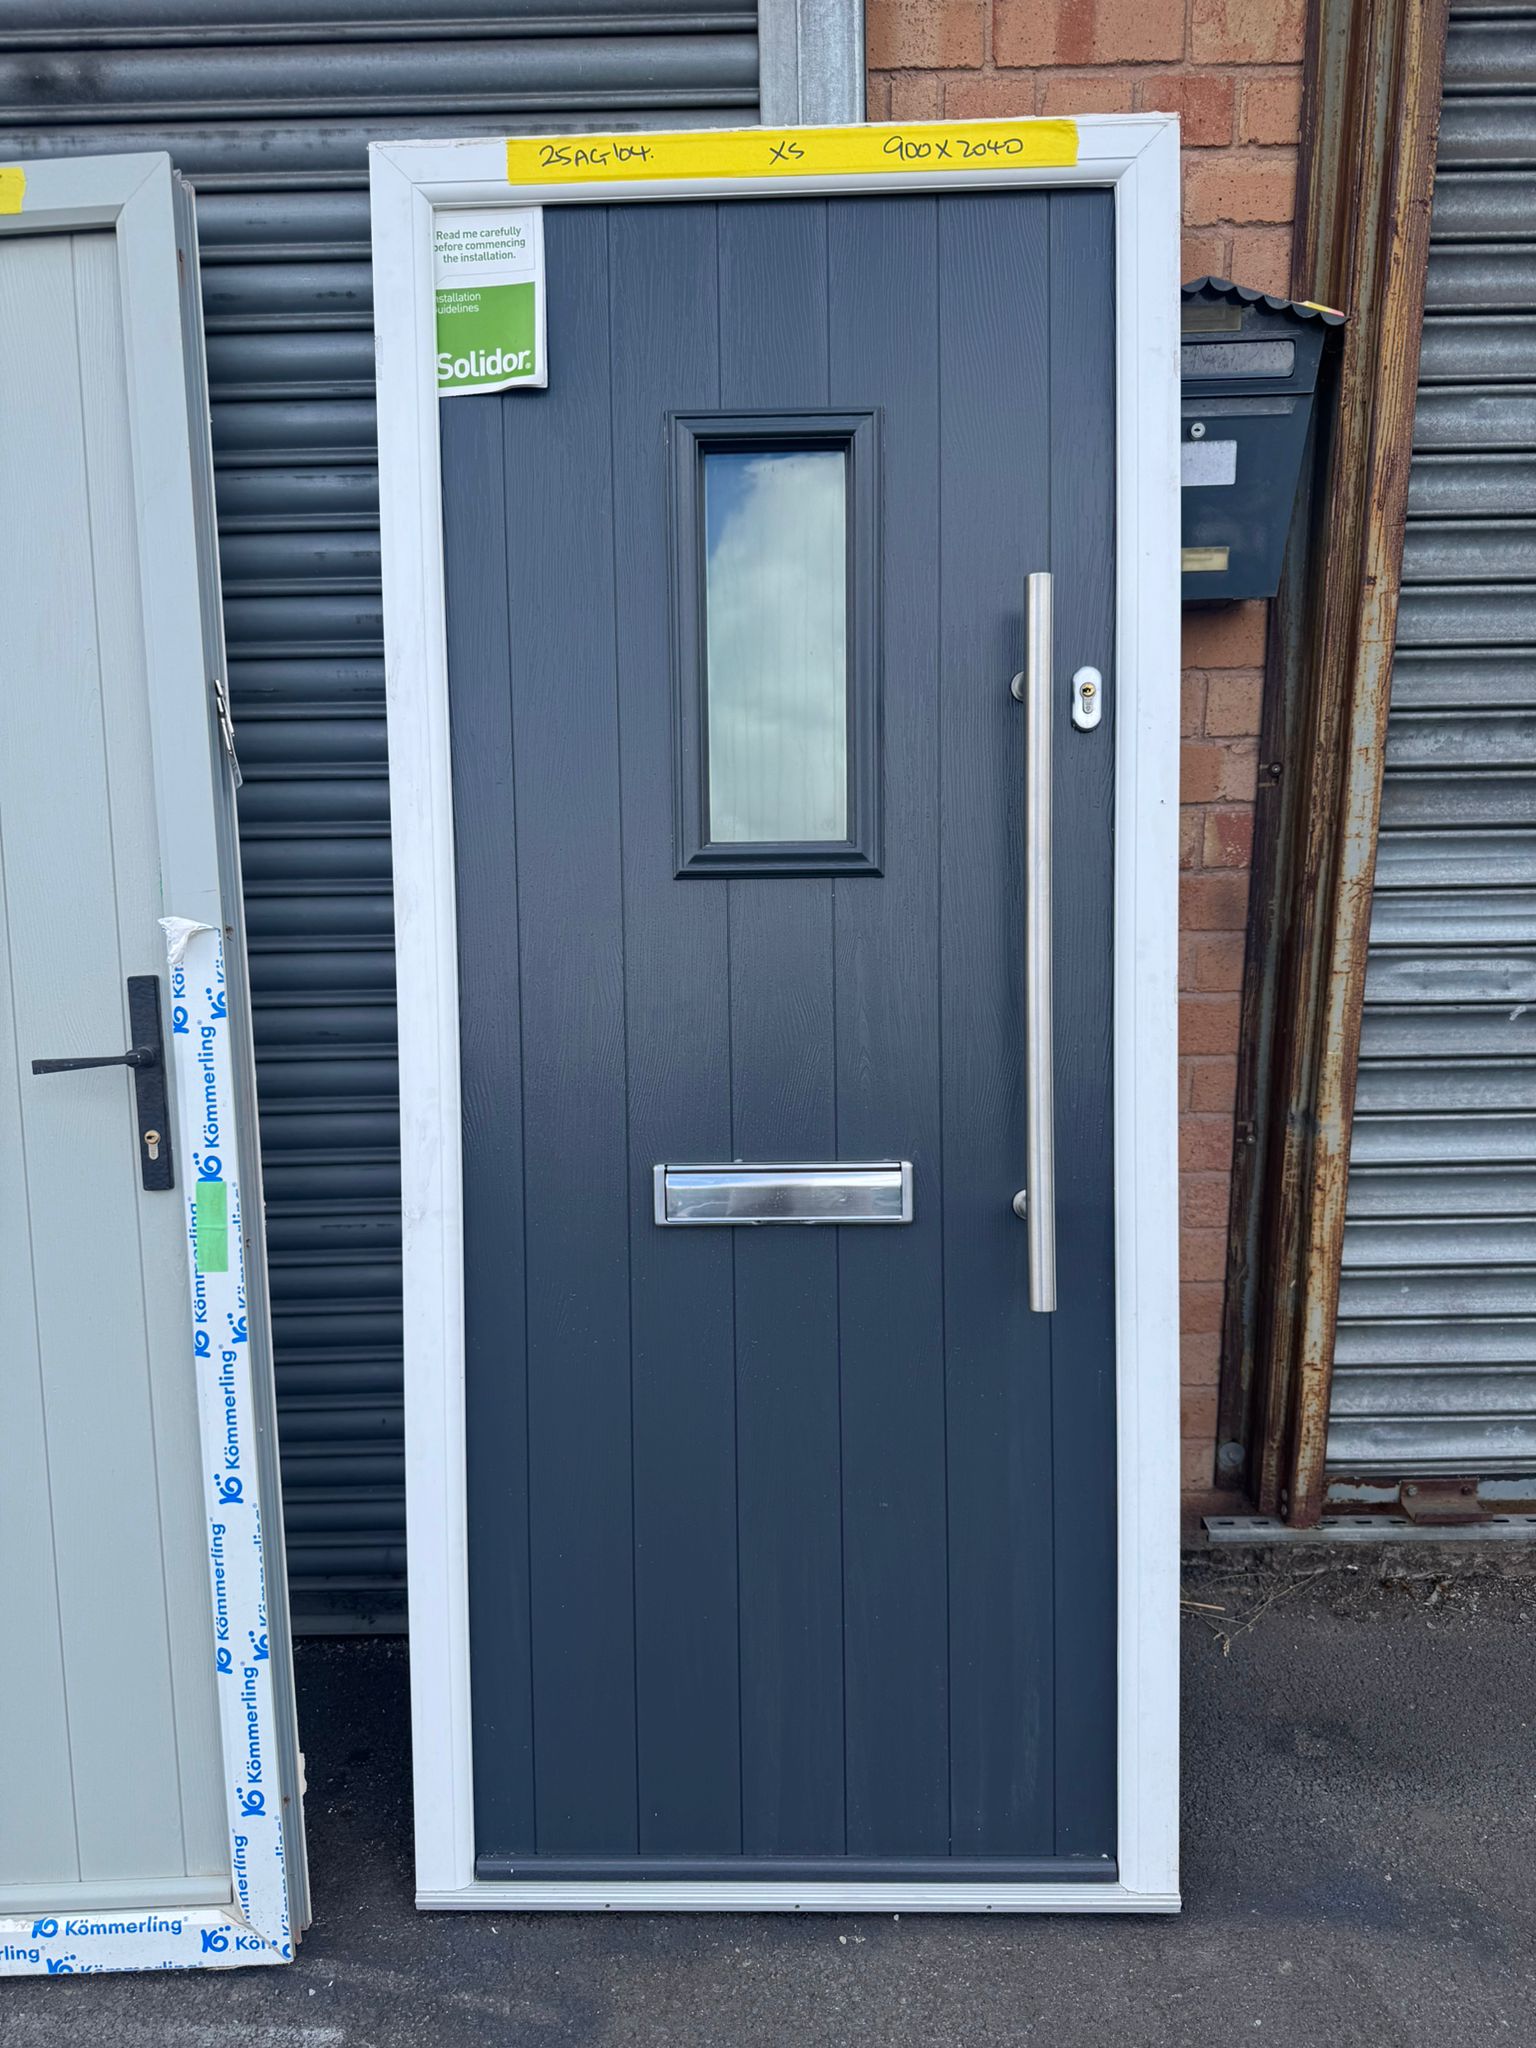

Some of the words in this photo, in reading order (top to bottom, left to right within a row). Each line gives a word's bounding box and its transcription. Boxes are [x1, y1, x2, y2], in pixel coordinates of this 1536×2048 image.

[769, 141, 805, 165] XS
[436, 230, 460, 240] Read
[463, 230, 478, 239] me
[480, 226, 521, 237] carefully
[465, 238, 526, 250] commencing
[443, 254, 459, 263] the
[461, 250, 516, 262] installation.
[437, 292, 481, 303] stallation
[437, 303, 480, 314] uidelines
[198, 1026, 220, 1148] Kömmerling
[219, 1350, 240, 1470] Kömmerling
[211, 1523, 230, 1641] Kömmerling
[241, 1666, 262, 1784] Kömmerling
[65, 1916, 182, 1936] Kömmerling
